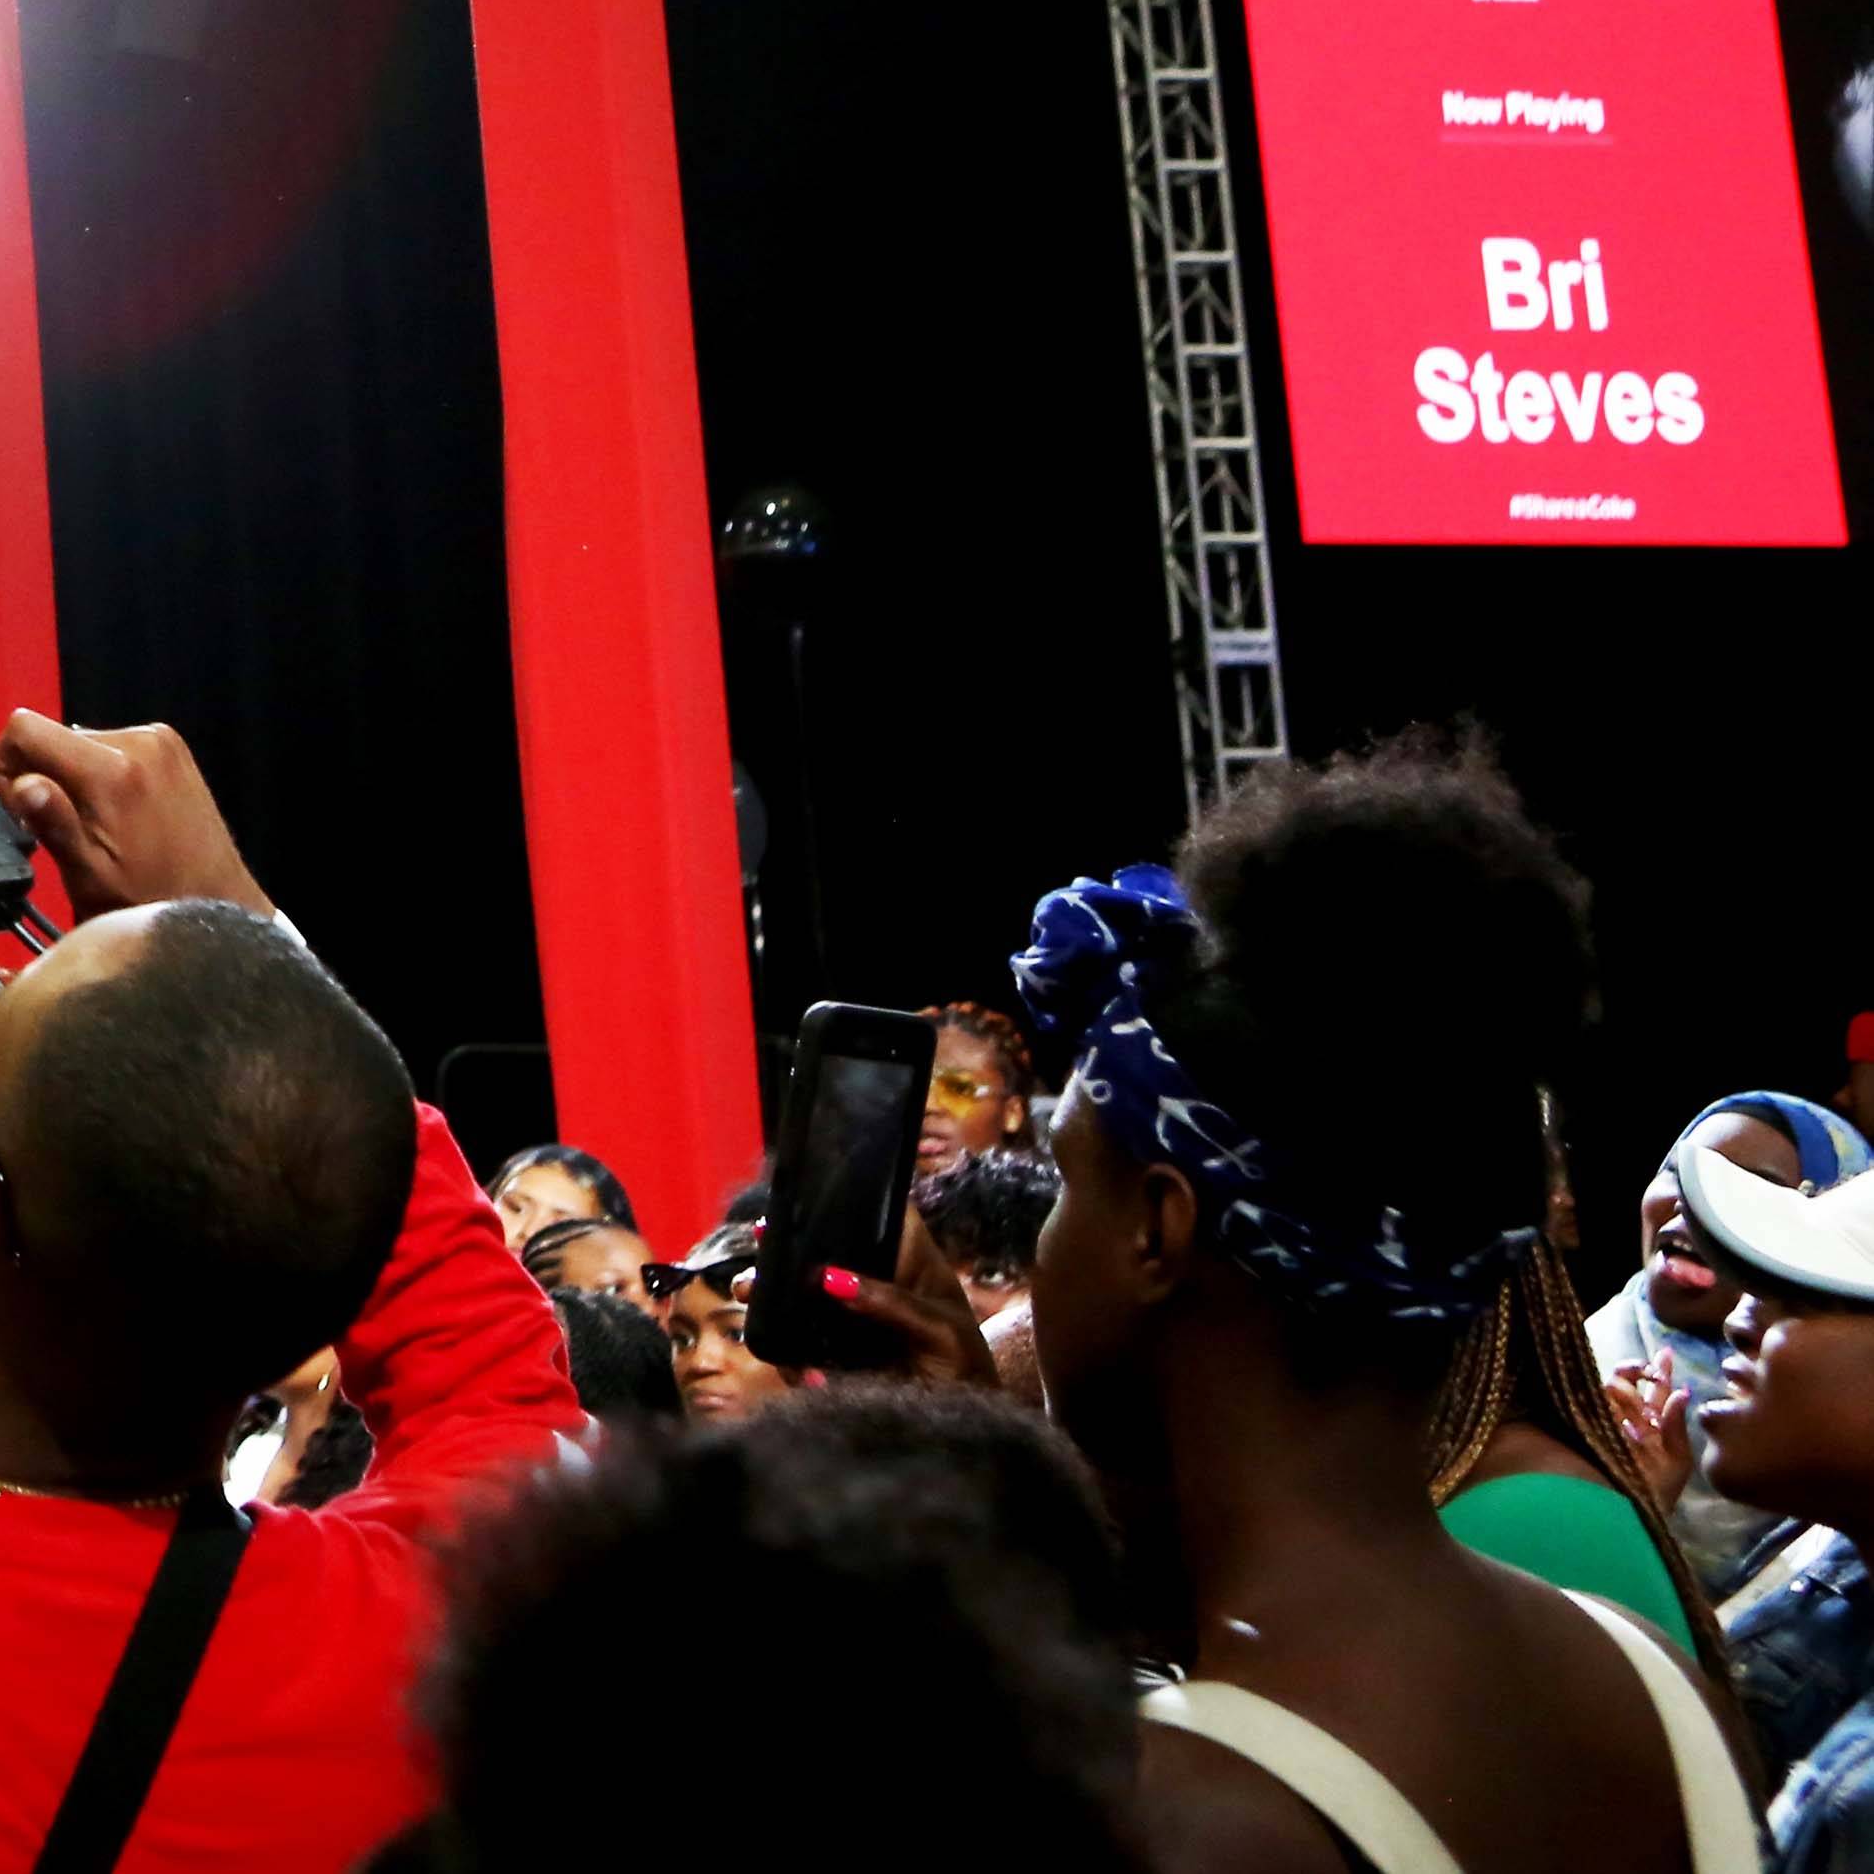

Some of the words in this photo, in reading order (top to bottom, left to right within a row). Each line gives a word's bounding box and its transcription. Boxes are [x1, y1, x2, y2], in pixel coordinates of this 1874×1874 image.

[1441, 89, 1502, 125] Now
[1505, 89, 1605, 133] Playing
[1481, 236, 1609, 332] Bri
[1413, 346, 1705, 445] Steves
